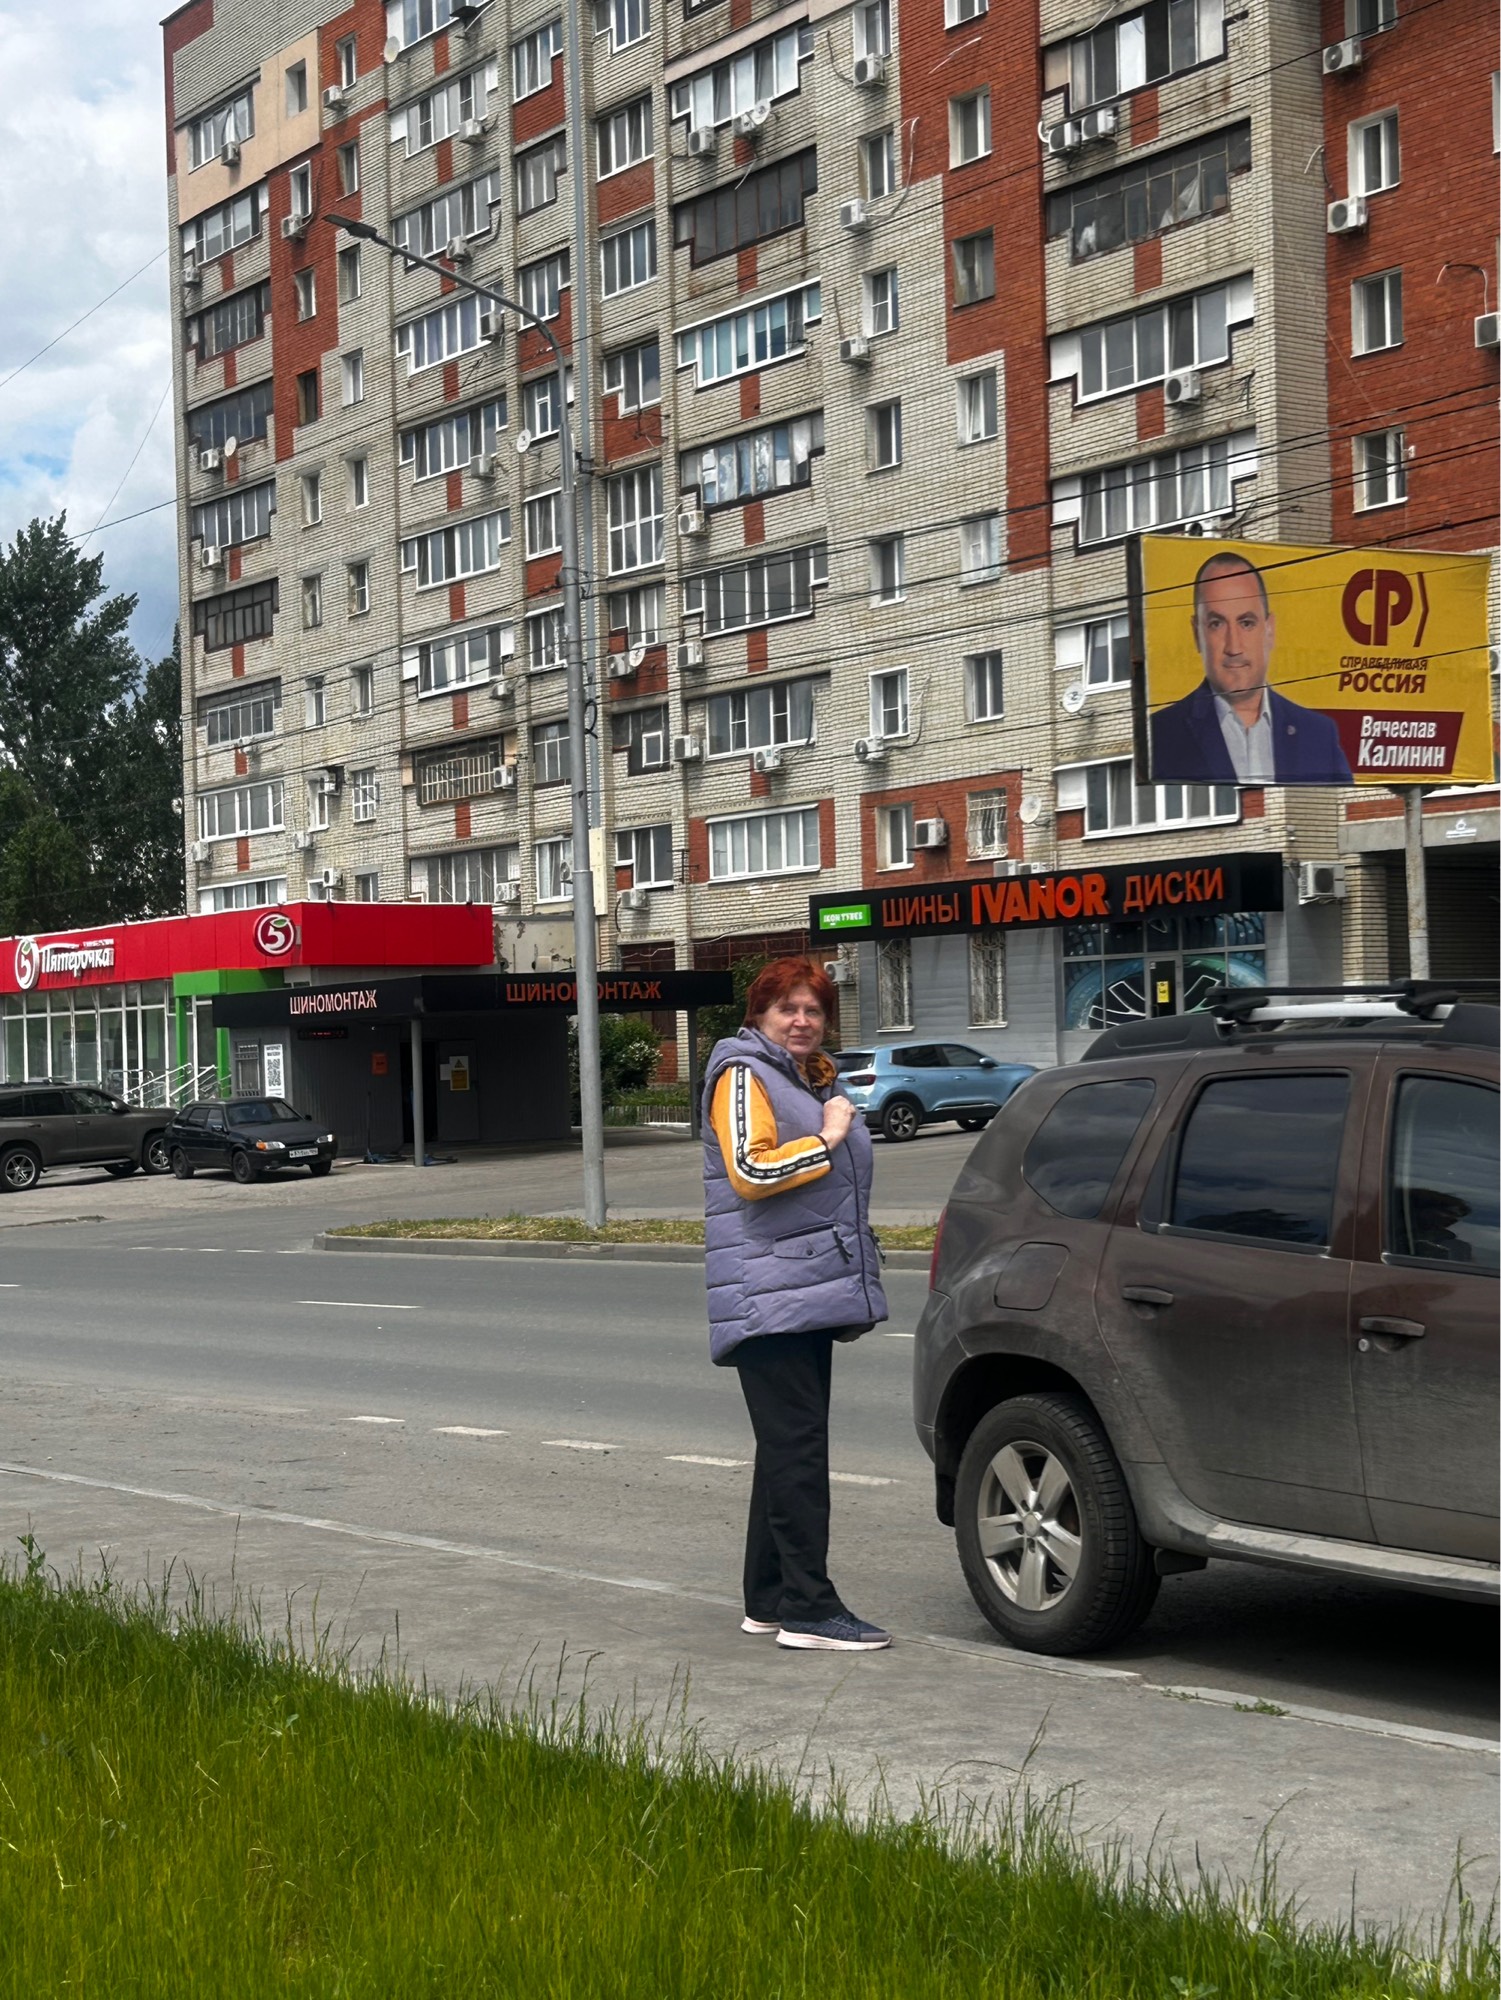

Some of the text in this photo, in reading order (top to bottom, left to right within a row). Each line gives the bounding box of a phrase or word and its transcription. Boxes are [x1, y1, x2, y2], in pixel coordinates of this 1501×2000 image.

[1339, 655, 1428, 672] СПРАВЕДЛИВАЯ
[1338, 671, 1427, 694] РОССИЯ
[1360, 715, 1437, 739] Вячеслав
[1357, 738, 1446, 767] Калинин
[882, 867, 1223, 927] ШИНЫ IVANOR ДИСКИ
[289, 989, 378, 1015] ШИНОМОНТАЖ
